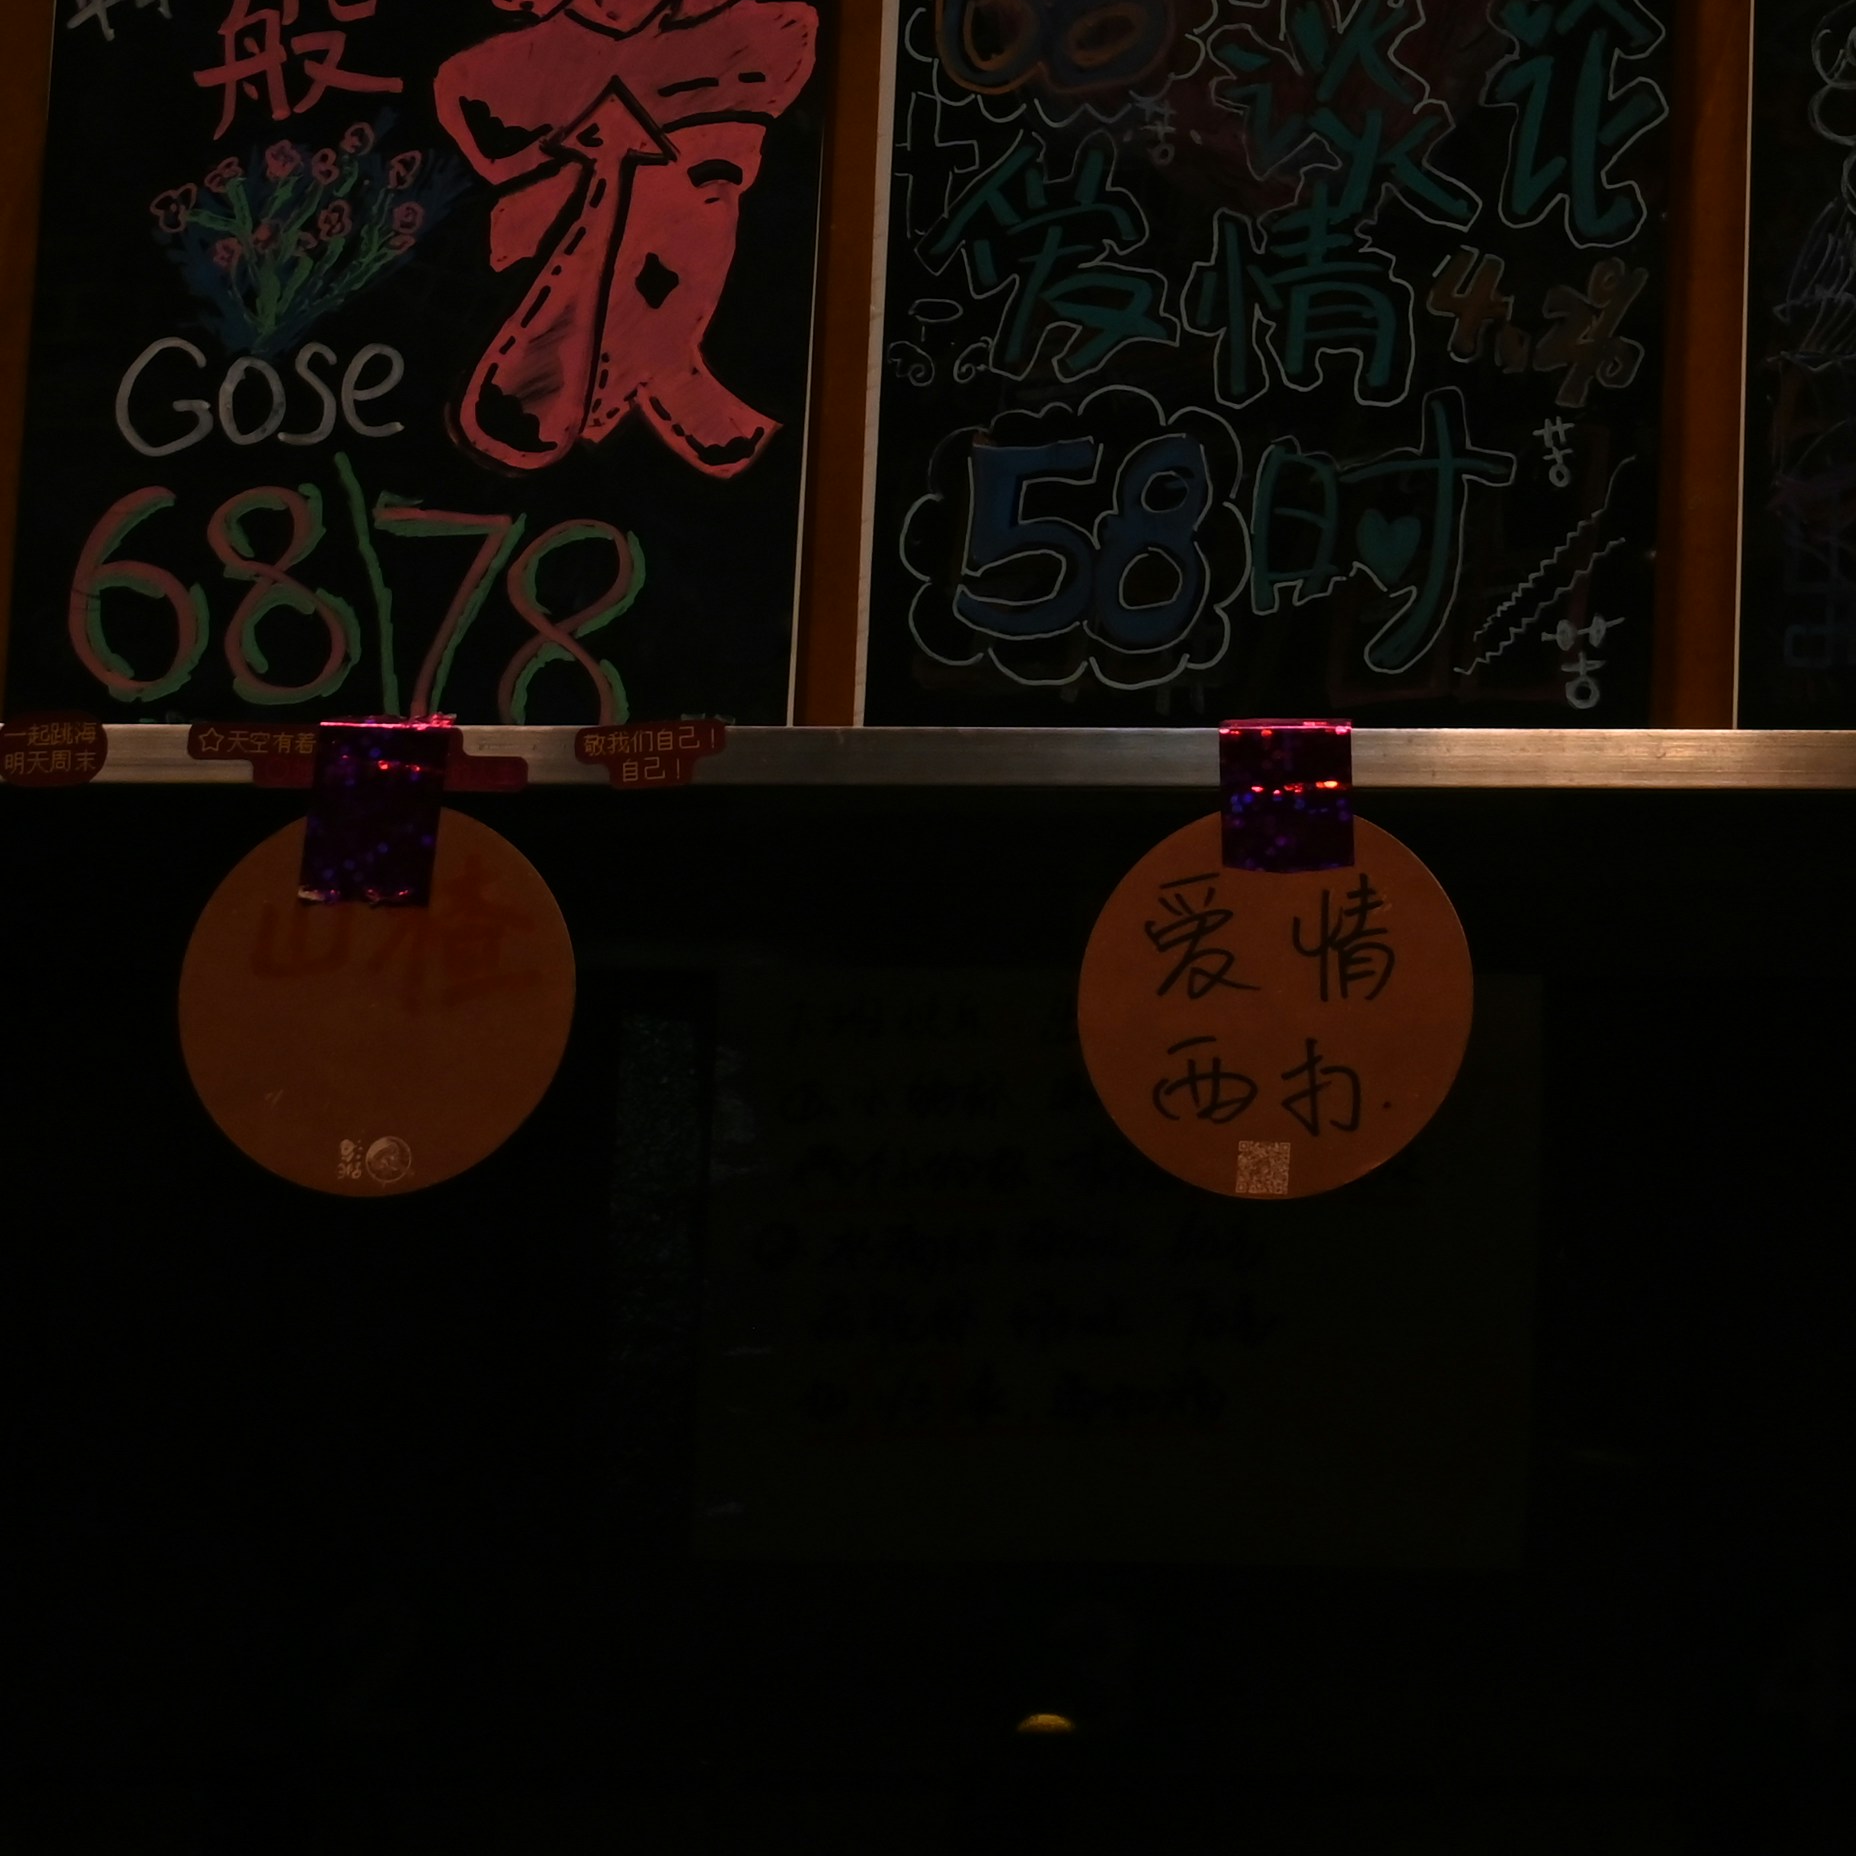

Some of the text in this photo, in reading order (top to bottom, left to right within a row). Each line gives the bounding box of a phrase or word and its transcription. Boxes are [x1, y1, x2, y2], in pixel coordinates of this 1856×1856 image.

[955, 434, 1211, 656] 58
[2, 721, 98, 746] 一起跳海
[2, 749, 98, 775] 明天周末
[226, 729, 317, 755] 天空有着
[1144, 872, 1397, 1003] 爱情
[1152, 1035, 1362, 1138] 西打
